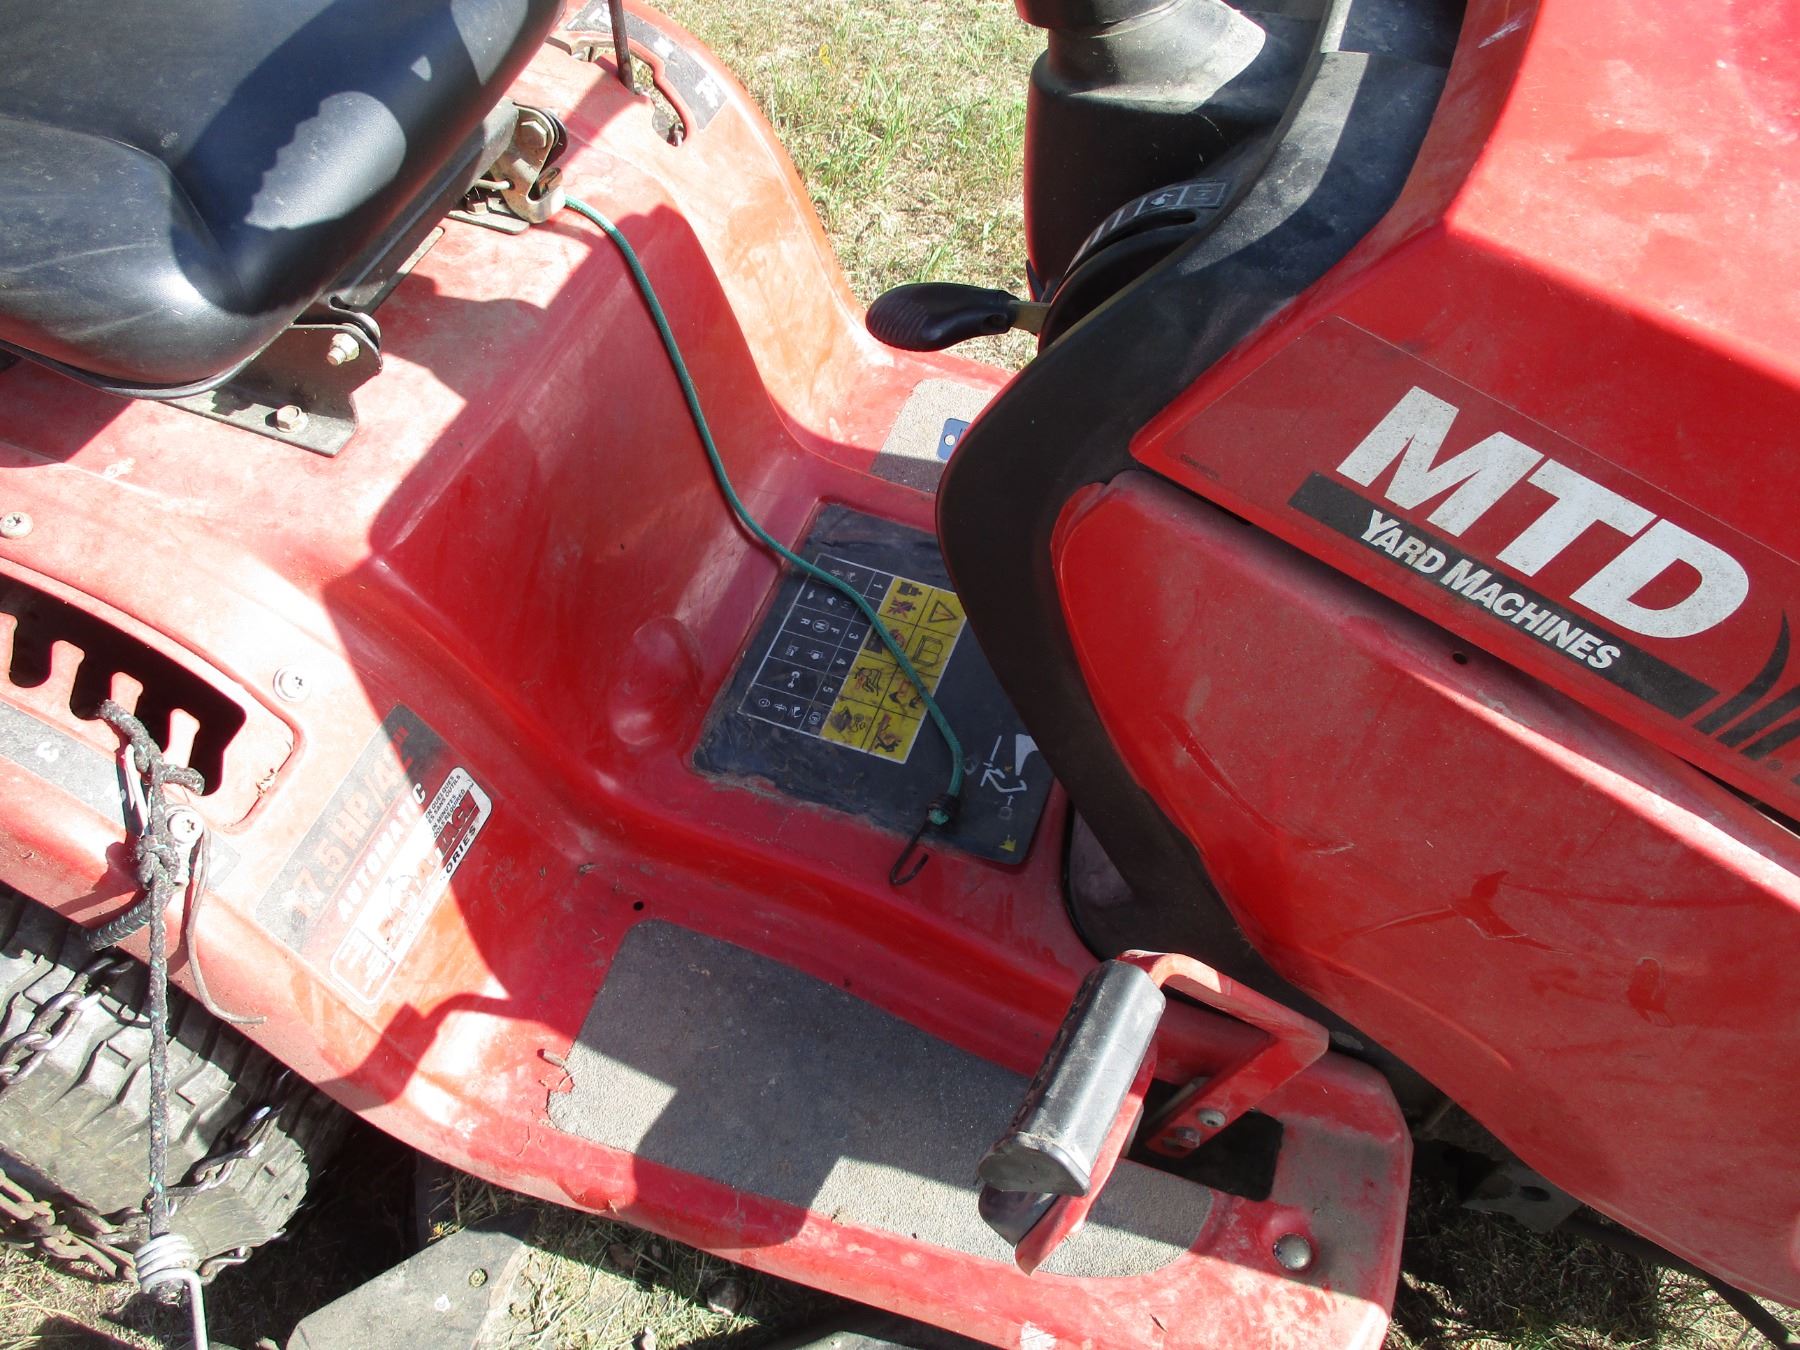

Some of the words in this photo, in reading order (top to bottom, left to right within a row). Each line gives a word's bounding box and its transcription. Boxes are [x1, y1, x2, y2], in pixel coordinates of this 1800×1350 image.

[1336, 385, 1749, 638] MTD
[1359, 509, 1446, 574] YARD
[1440, 559, 1621, 669] MACHINES
[338, 783, 426, 922] AUTOMATIC
